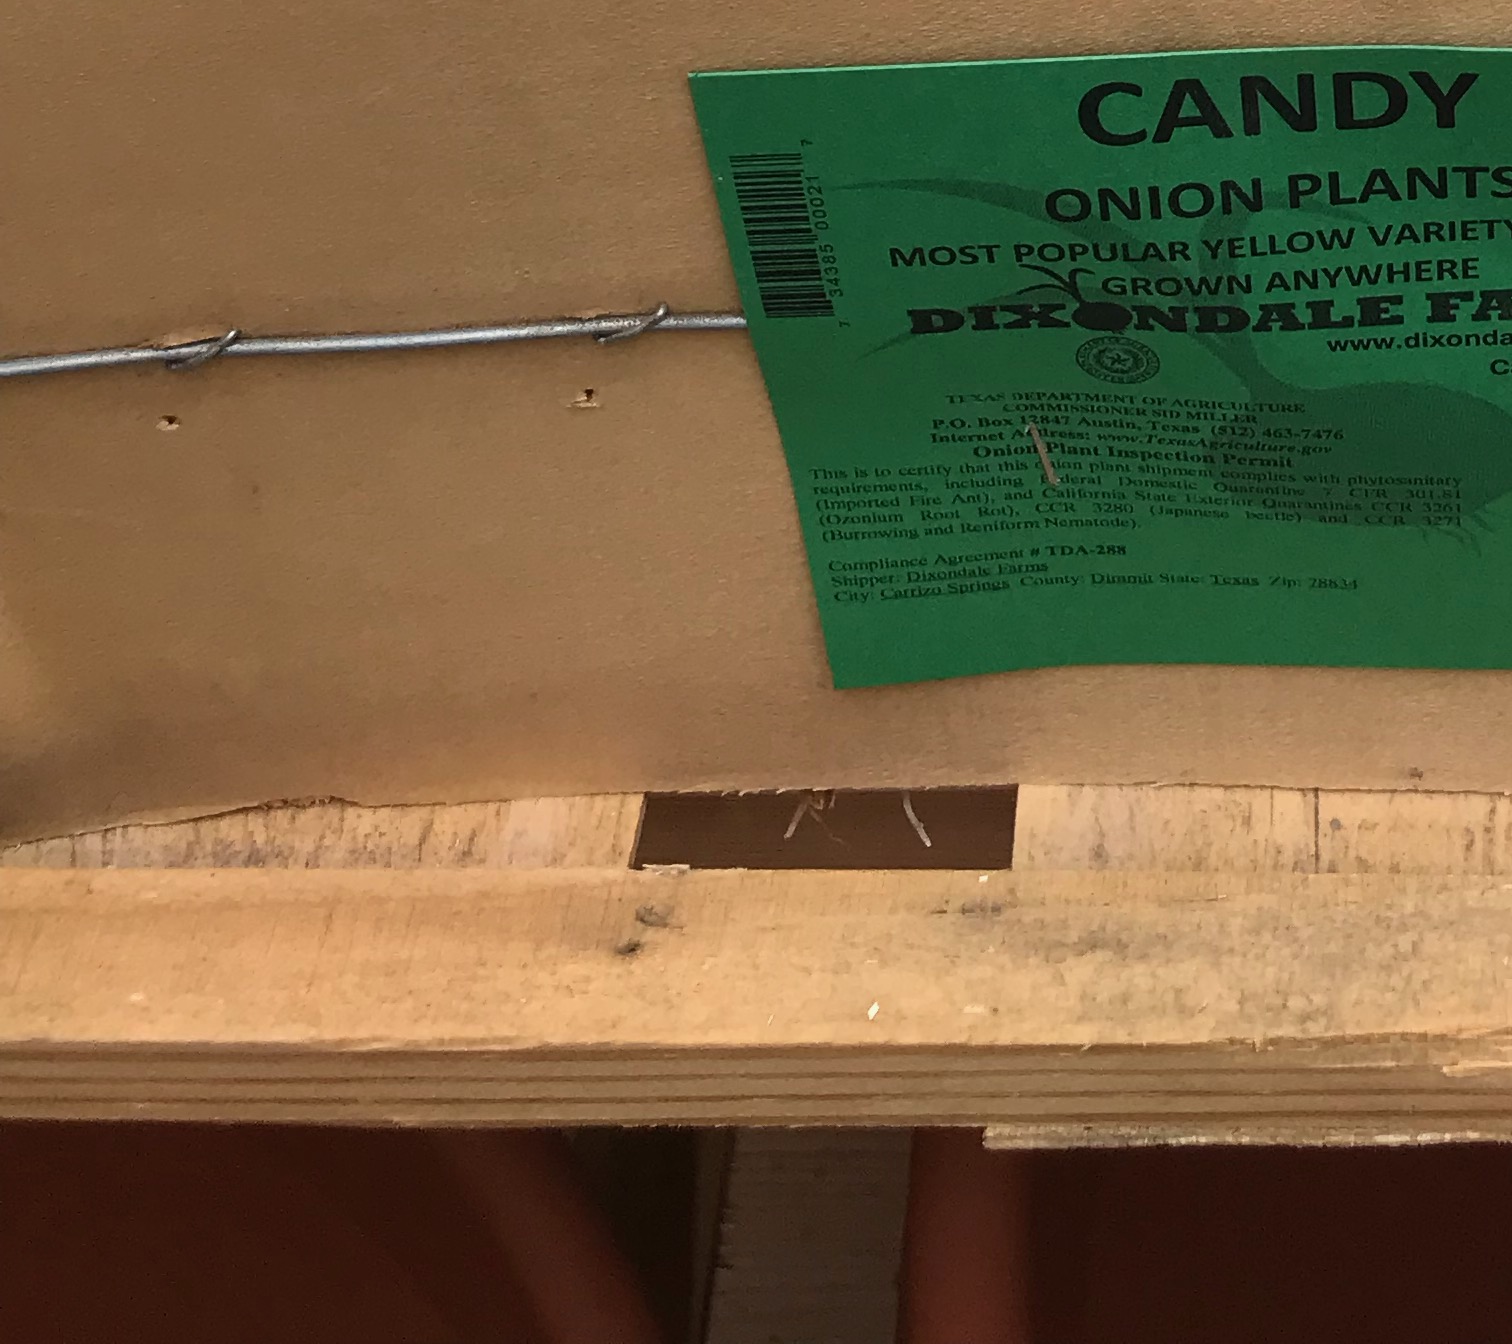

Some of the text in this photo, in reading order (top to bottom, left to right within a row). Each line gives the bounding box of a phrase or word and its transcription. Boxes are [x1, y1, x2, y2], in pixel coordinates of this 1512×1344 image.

[1077, 70, 1480, 147] CANDY
[806, 176, 829, 230] 00021
[1045, 178, 1263, 224] ONION
[890, 244, 1001, 267] MOST
[1014, 241, 1192, 263] POPULAR
[1201, 226, 1355, 260] YELLOW
[819, 244, 844, 297] 34385
[1101, 257, 1480, 297] GROWN ANYWHERE
[907, 293, 1404, 334] DIXONDALE
[945, 392, 1306, 413] TEXAS DEPARTMENT OF AGRICULTURE
[1002, 403, 1258, 424] COMMISSIONER SID MILLER
[932, 415, 1344, 440] P.O. Box 12847 Austin, Texas (512) 463-7476
[930, 431, 1005, 443] Internet
[1097, 432, 1333, 455] www.TexasAgriculture.gov
[973, 442, 1293, 468] Onion Plant Inspection Permit
[810, 468, 848, 480] This
[854, 467, 868, 478] is
[874, 468, 892, 478] to
[899, 463, 952, 478] certify
[959, 463, 990, 474] that
[998, 460, 1028, 472] this
[1089, 461, 1131, 474] plant
[1137, 463, 1212, 479] shipment
[1220, 469, 1296, 483] complies
[1303, 472, 1340, 484] with
[1347, 474, 1461, 488] phytosanitary
[813, 482, 928, 495] requirements,
[945, 475, 1023, 490] including
[1118, 476, 1197, 490] Domestic
[1213, 481, 1305, 496] Quarantine
[1349, 488, 1388, 498] CFR
[816, 496, 900, 511] (Imported
[909, 494, 942, 506] Fire
[1004, 489, 1033, 501] and
[1042, 486, 1126, 500] California
[1134, 490, 1177, 503] State
[1262, 497, 1362, 512] Quarantines
[819, 512, 904, 526] (Ozonium
[921, 508, 960, 520] Root
[1035, 501, 1076, 513] CCR
[1092, 502, 1134, 514] 3280
[1149, 505, 1230, 520] (Japanese
[1245, 510, 1302, 523] beetle)
[1318, 513, 1348, 524] and
[822, 527, 919, 542] (Burrowing
[924, 524, 953, 536] and
[961, 519, 1040, 533] Reniform
[828, 556, 928, 572] Compliance
[934, 549, 1024, 566] Agreement
[1045, 543, 1127, 557] TDA-288
[831, 561, 1048, 588] Shipper: Dixondale Farms
[834, 590, 873, 603] City:
[880, 586, 942, 602] Carrizo
[947, 579, 1010, 596] Springs
[1020, 573, 1084, 587] County:
[1091, 572, 1154, 585] Dimmit
[1210, 574, 1260, 586] Texas
